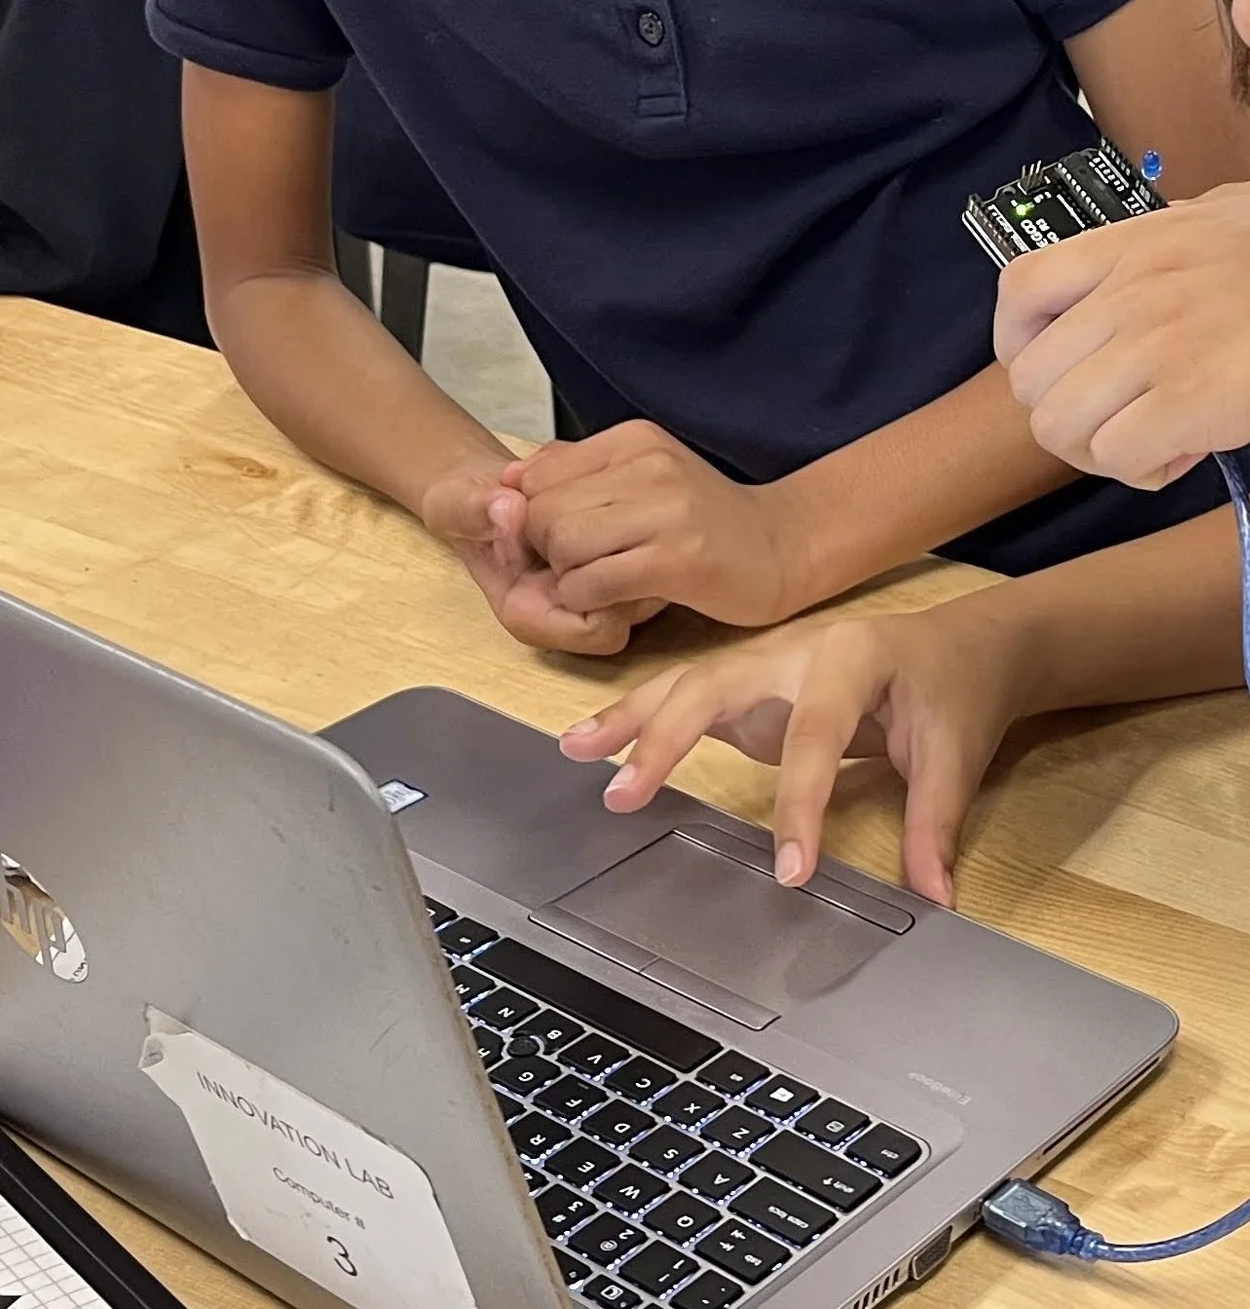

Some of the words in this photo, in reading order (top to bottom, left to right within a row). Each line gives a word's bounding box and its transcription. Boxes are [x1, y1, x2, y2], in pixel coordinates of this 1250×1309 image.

[1021, 219, 1049, 248] EGOO
[497, 1007, 515, 1018] N
[547, 1029, 562, 1040] B
[586, 1054, 602, 1064] V
[518, 1071, 534, 1082] G
[635, 1078, 651, 1089] C
[565, 1098, 583, 1108] F
[683, 1102, 701, 1114] X
[614, 1123, 631, 1133] D
[732, 1127, 749, 1139] Z
[197, 1071, 341, 1169] INNOVATION
[344, 1157, 394, 1200] LAB
[530, 1134, 546, 1146] R
[663, 1148, 679, 1160] S
[577, 1161, 595, 1173] E
[714, 1173, 730, 1185] A
[273, 1167, 351, 1222] Computer
[619, 1185, 640, 1199] W
[568, 1201, 583, 1212] 3
[677, 1215, 694, 1227] Q
[618, 1229, 635, 1240] 2
[600, 1240, 618, 1251] @
[327, 1236, 357, 1277] 3
